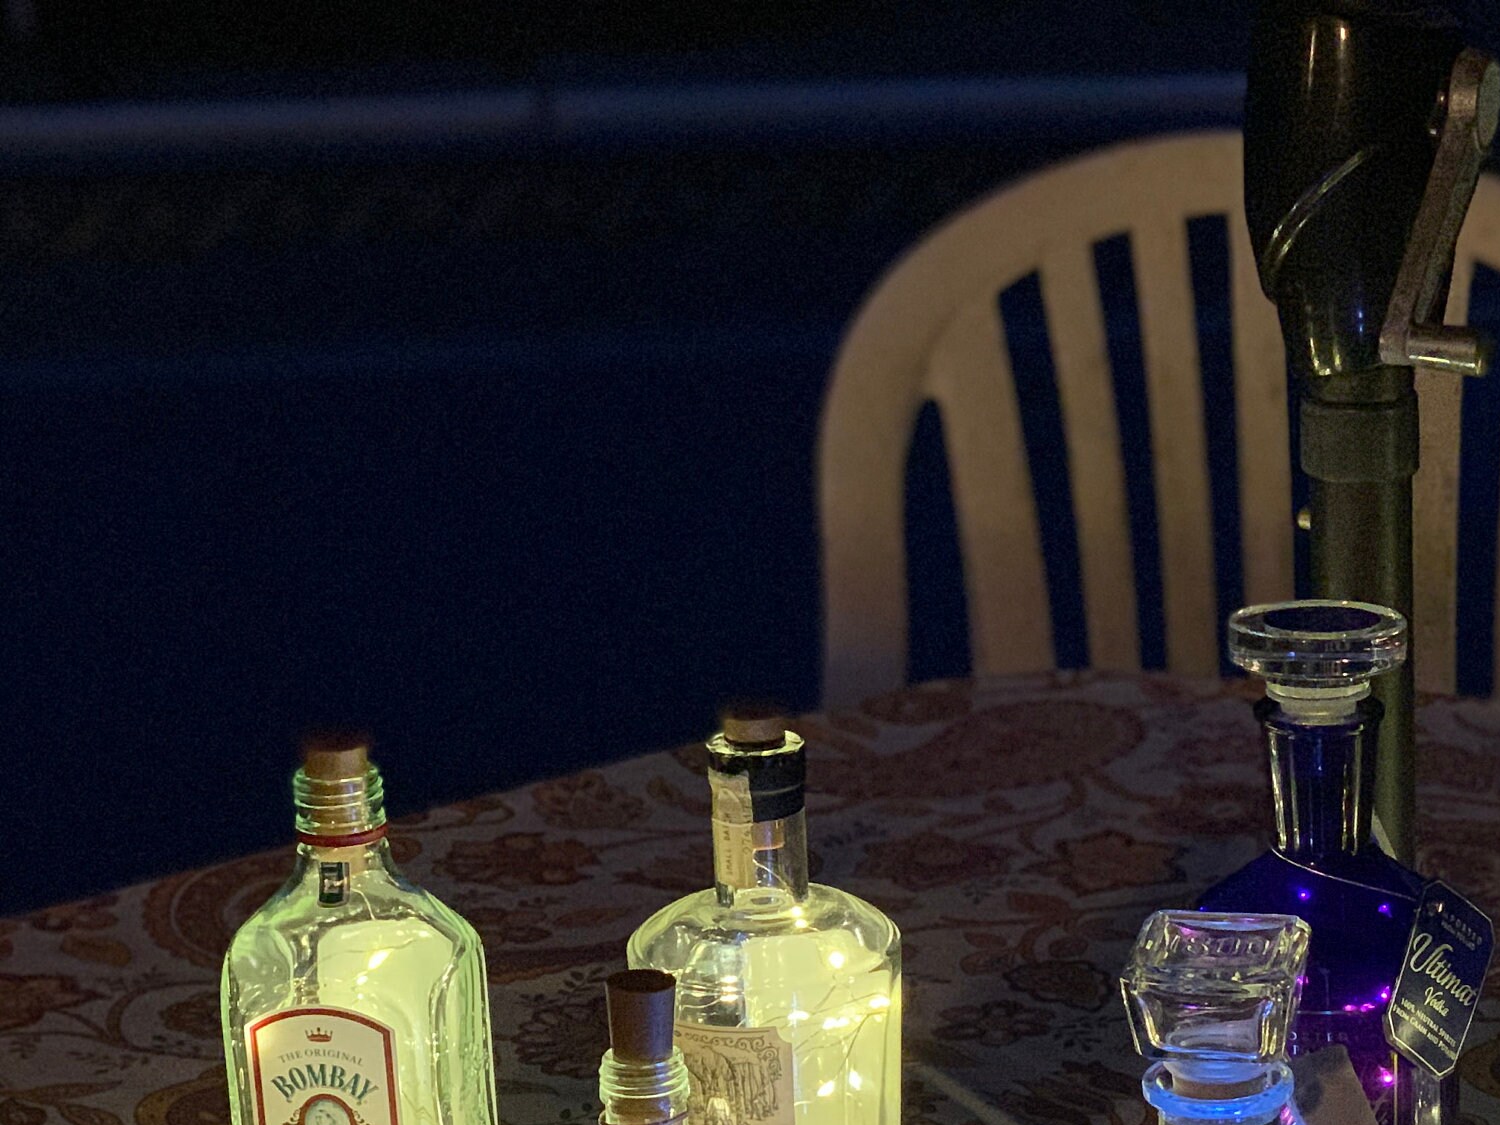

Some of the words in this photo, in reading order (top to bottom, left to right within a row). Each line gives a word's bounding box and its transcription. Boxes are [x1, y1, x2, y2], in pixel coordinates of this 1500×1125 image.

[1410, 932, 1478, 1006] Ultimat
[1424, 986, 1450, 1017] Vodka
[279, 1050, 303, 1064] THE
[304, 1048, 365, 1067] ORIGINAL
[271, 1063, 379, 1106] BOMBAY
